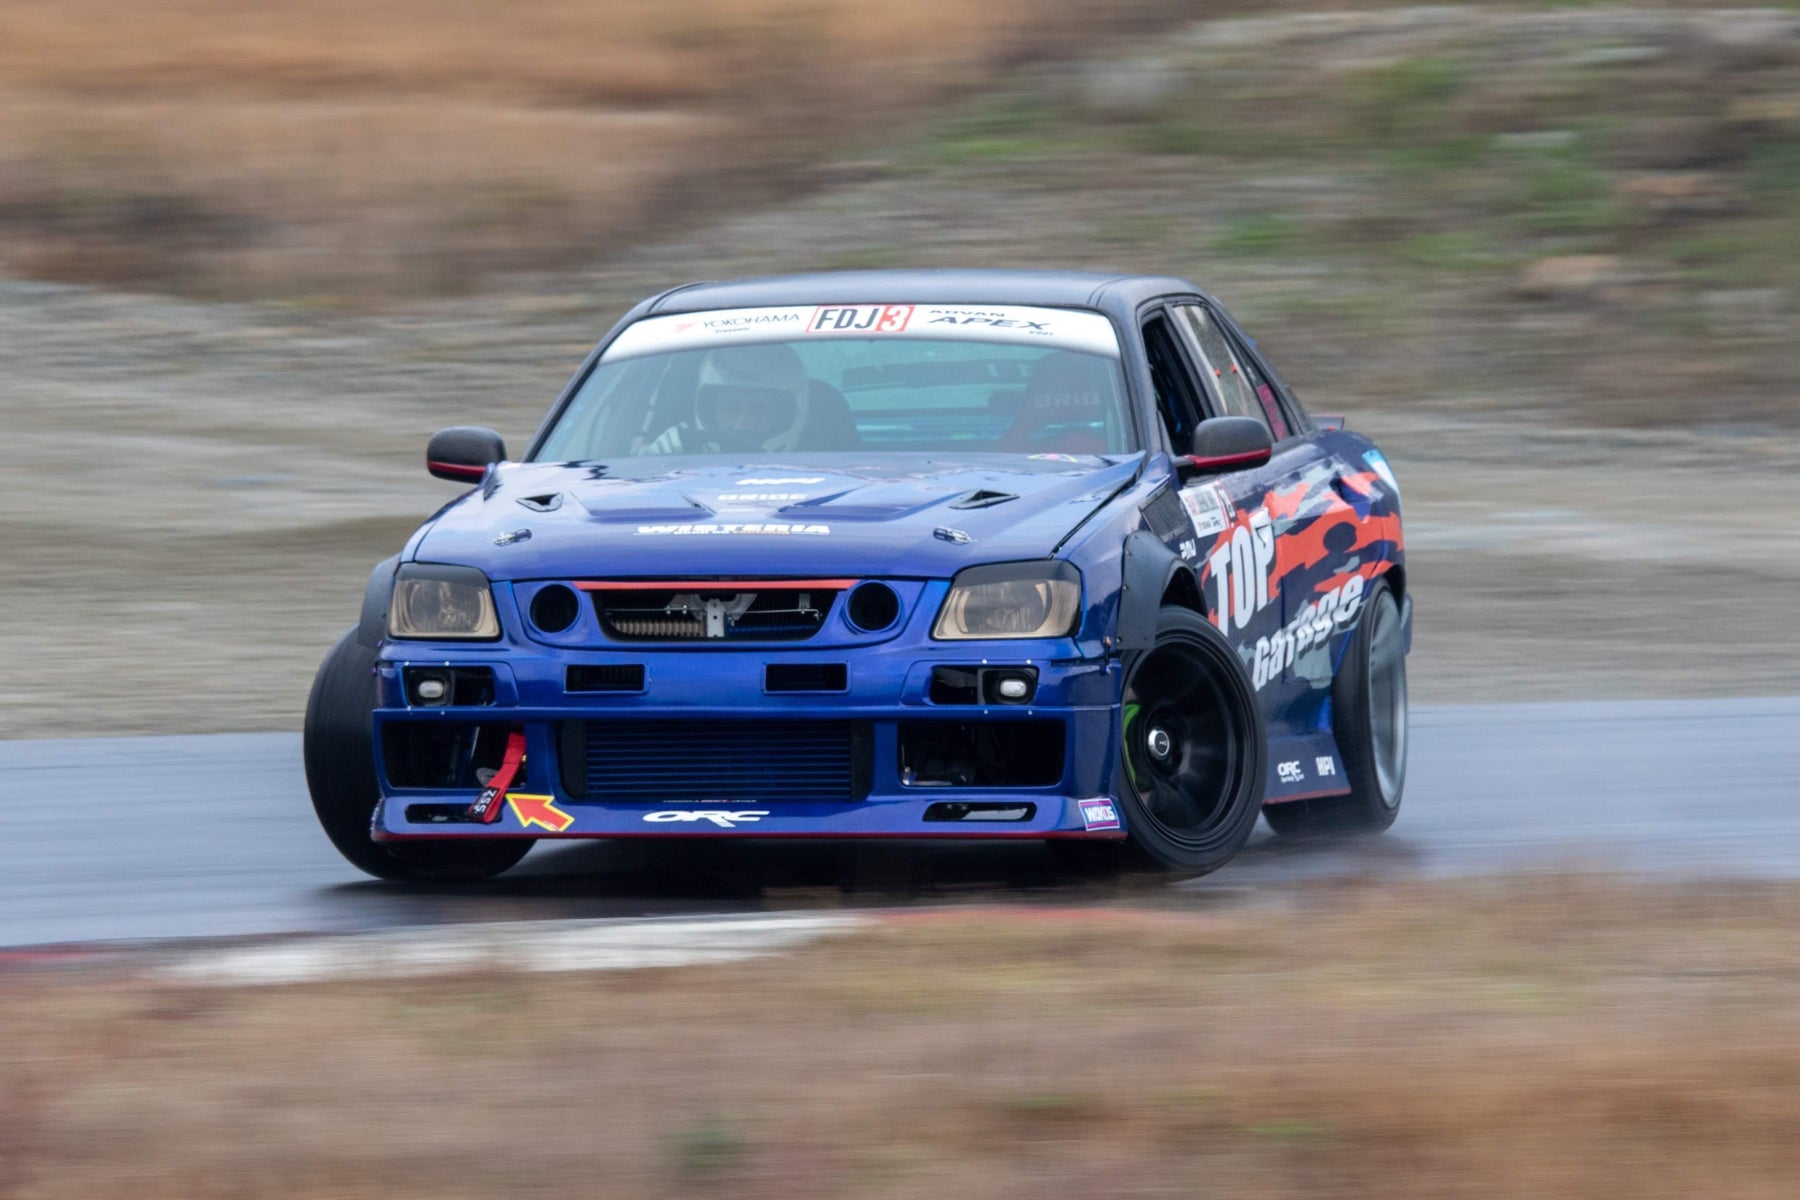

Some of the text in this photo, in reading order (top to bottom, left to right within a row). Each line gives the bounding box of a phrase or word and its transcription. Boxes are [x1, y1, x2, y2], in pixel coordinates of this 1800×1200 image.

[703, 313, 800, 328] YOKOHAMA
[929, 309, 1005, 317] ADVAN
[928, 316, 1051, 330] APEX
[1210, 507, 1275, 637] TOP
[1252, 575, 1364, 691] Garage
[1277, 760, 1301, 779] ORC
[642, 810, 770, 827] ORC
